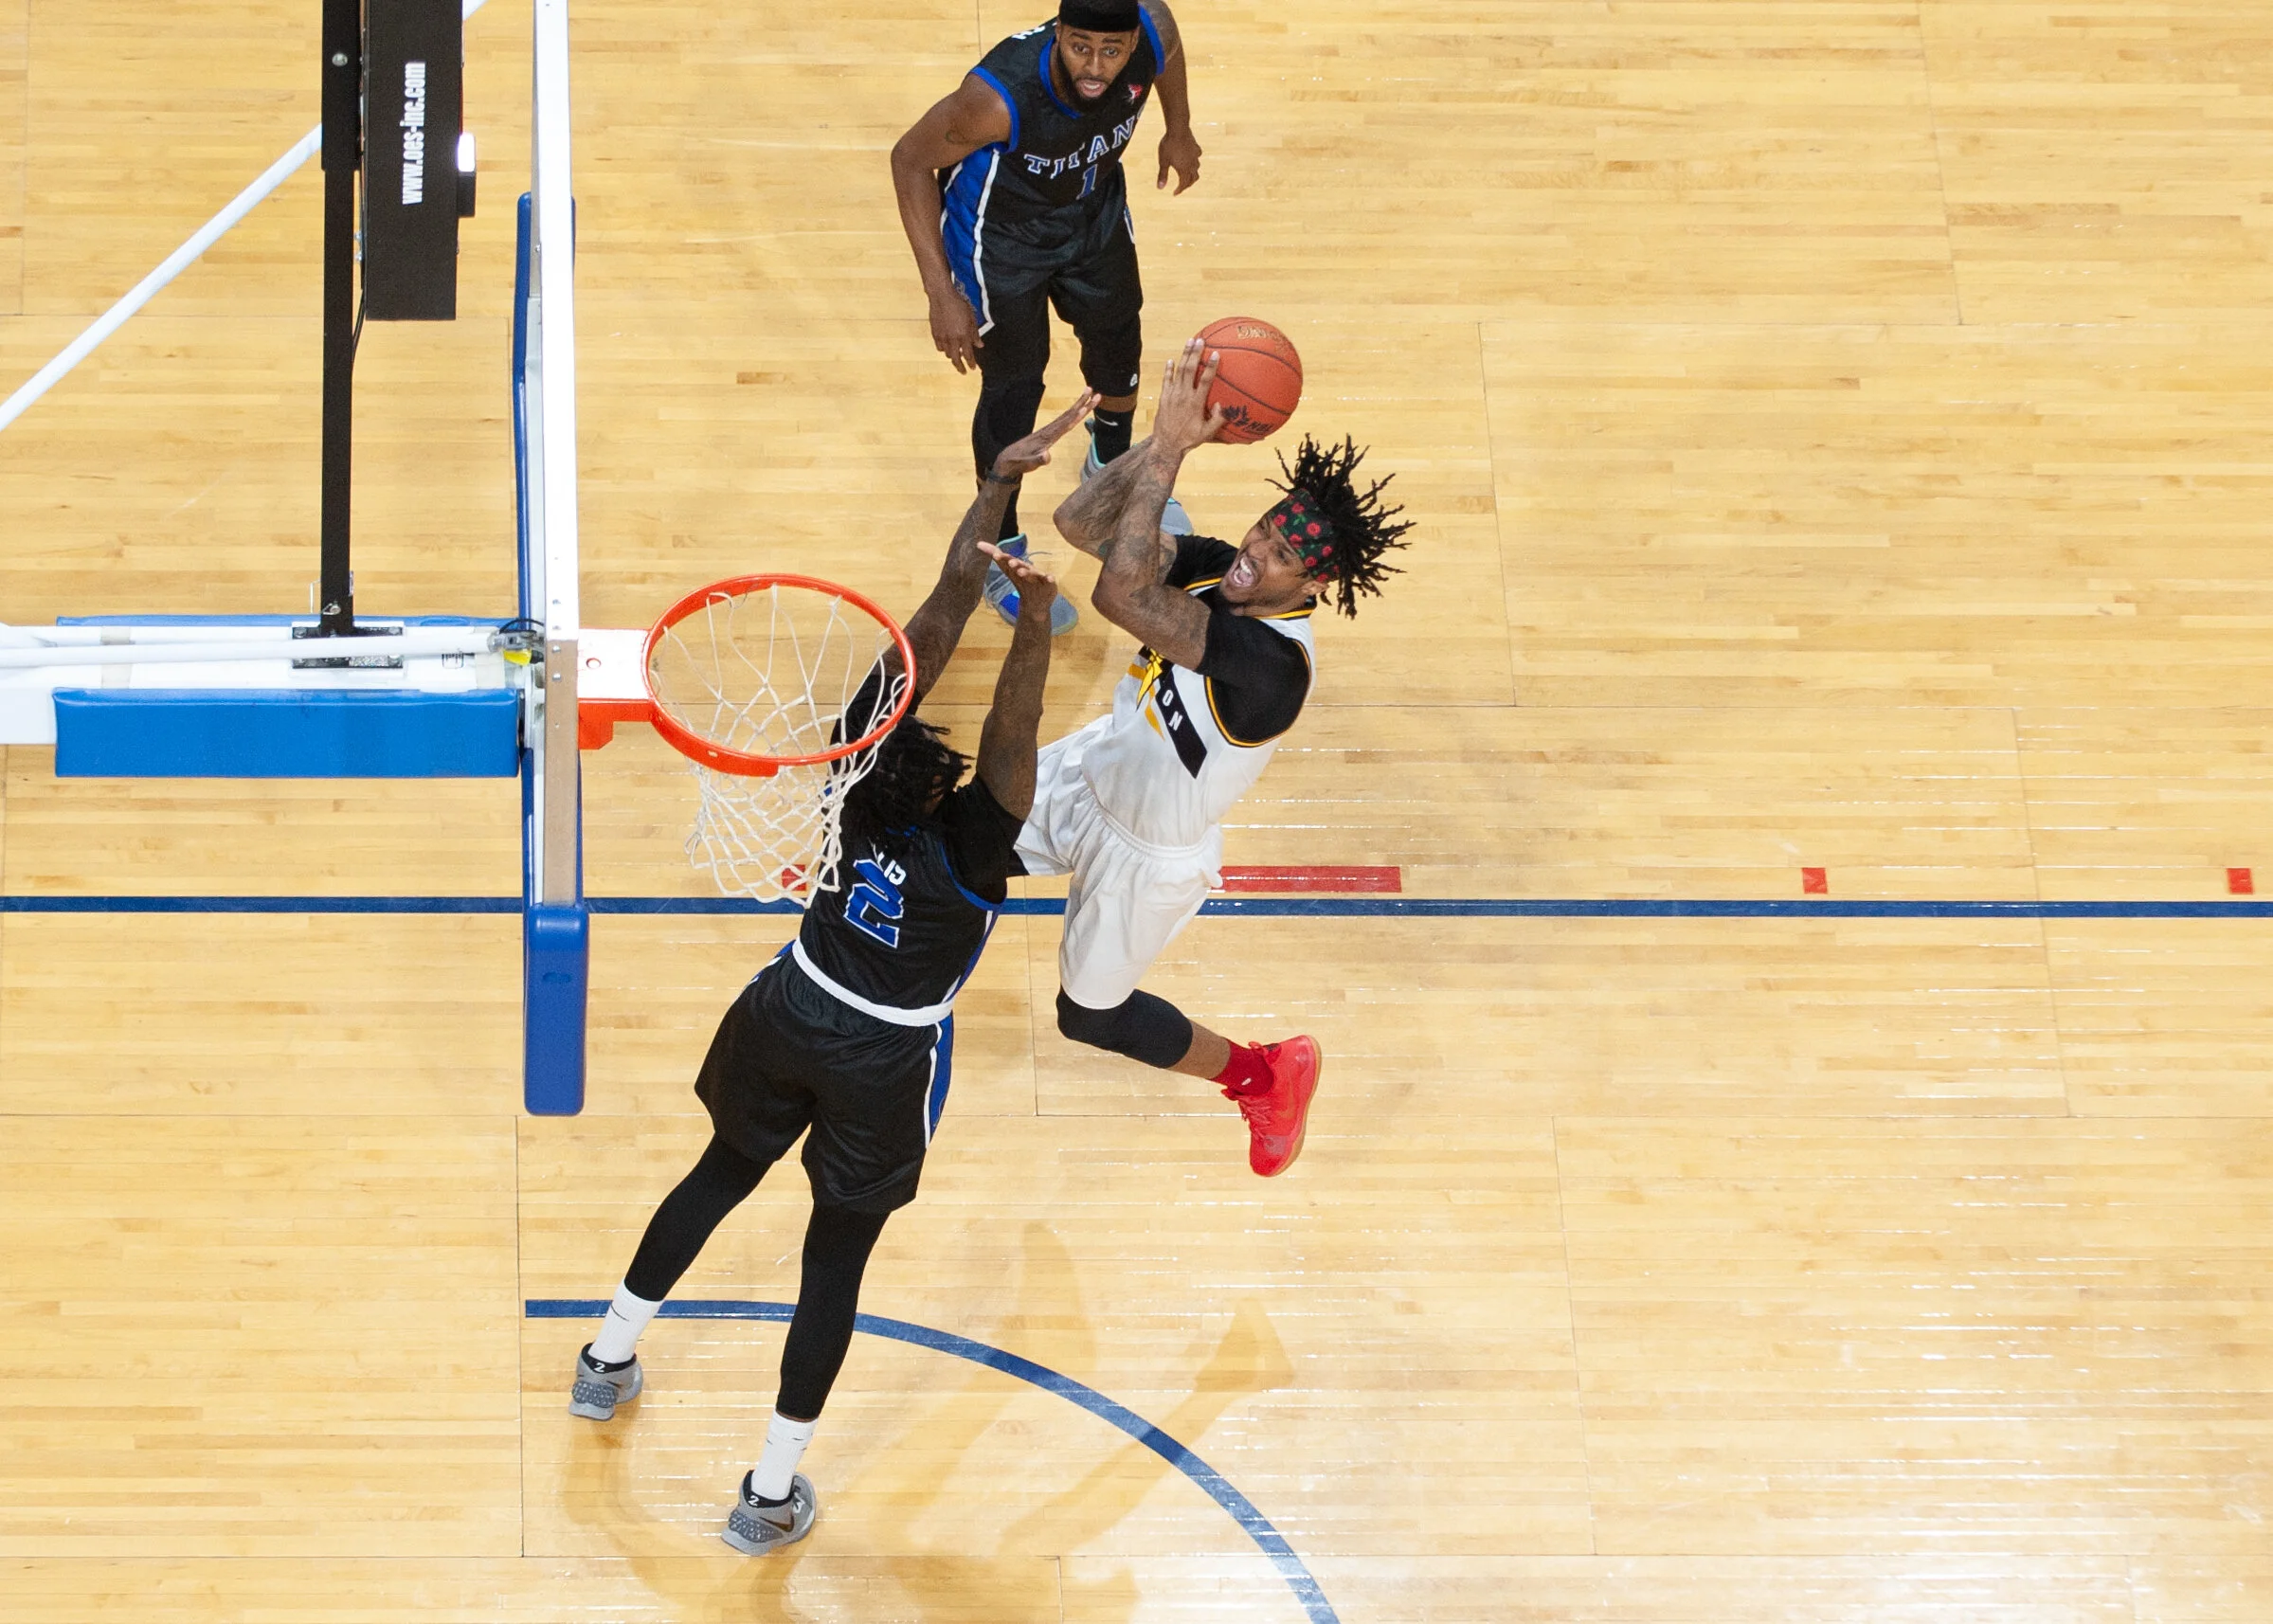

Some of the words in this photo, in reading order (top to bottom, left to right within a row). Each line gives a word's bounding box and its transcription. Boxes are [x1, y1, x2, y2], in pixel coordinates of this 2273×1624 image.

[399, 61, 426, 206] www.oes-inc.com
[1023, 105, 1146, 180] TITAN
[1075, 163, 1098, 201] 1
[842, 857, 905, 949] 2
[593, 1362, 606, 1374] 2
[748, 1494, 760, 1507] 2
